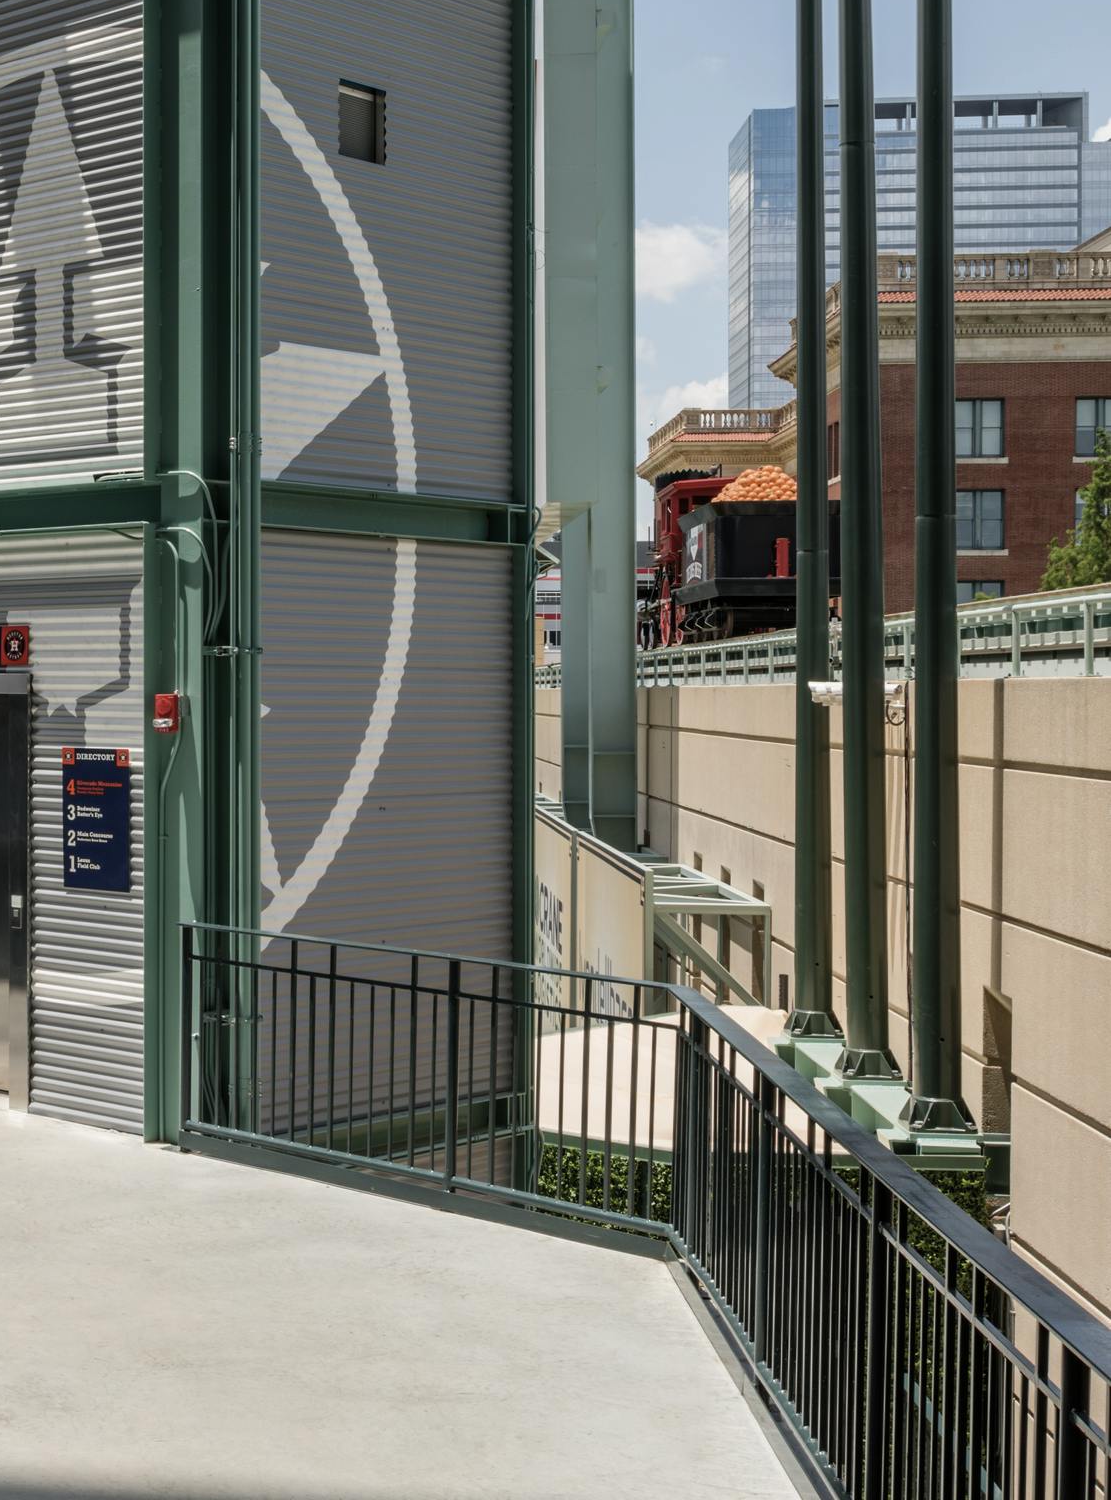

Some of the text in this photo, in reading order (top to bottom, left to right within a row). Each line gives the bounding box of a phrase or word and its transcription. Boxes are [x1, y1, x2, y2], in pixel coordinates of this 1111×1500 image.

[76, 753, 115, 761] DIRECTORY
[67, 779, 75, 795] 4
[67, 804, 76, 820] 3
[67, 830, 76, 846] 2
[69, 855, 76, 872] 1
[540, 882, 563, 955] CRANE
